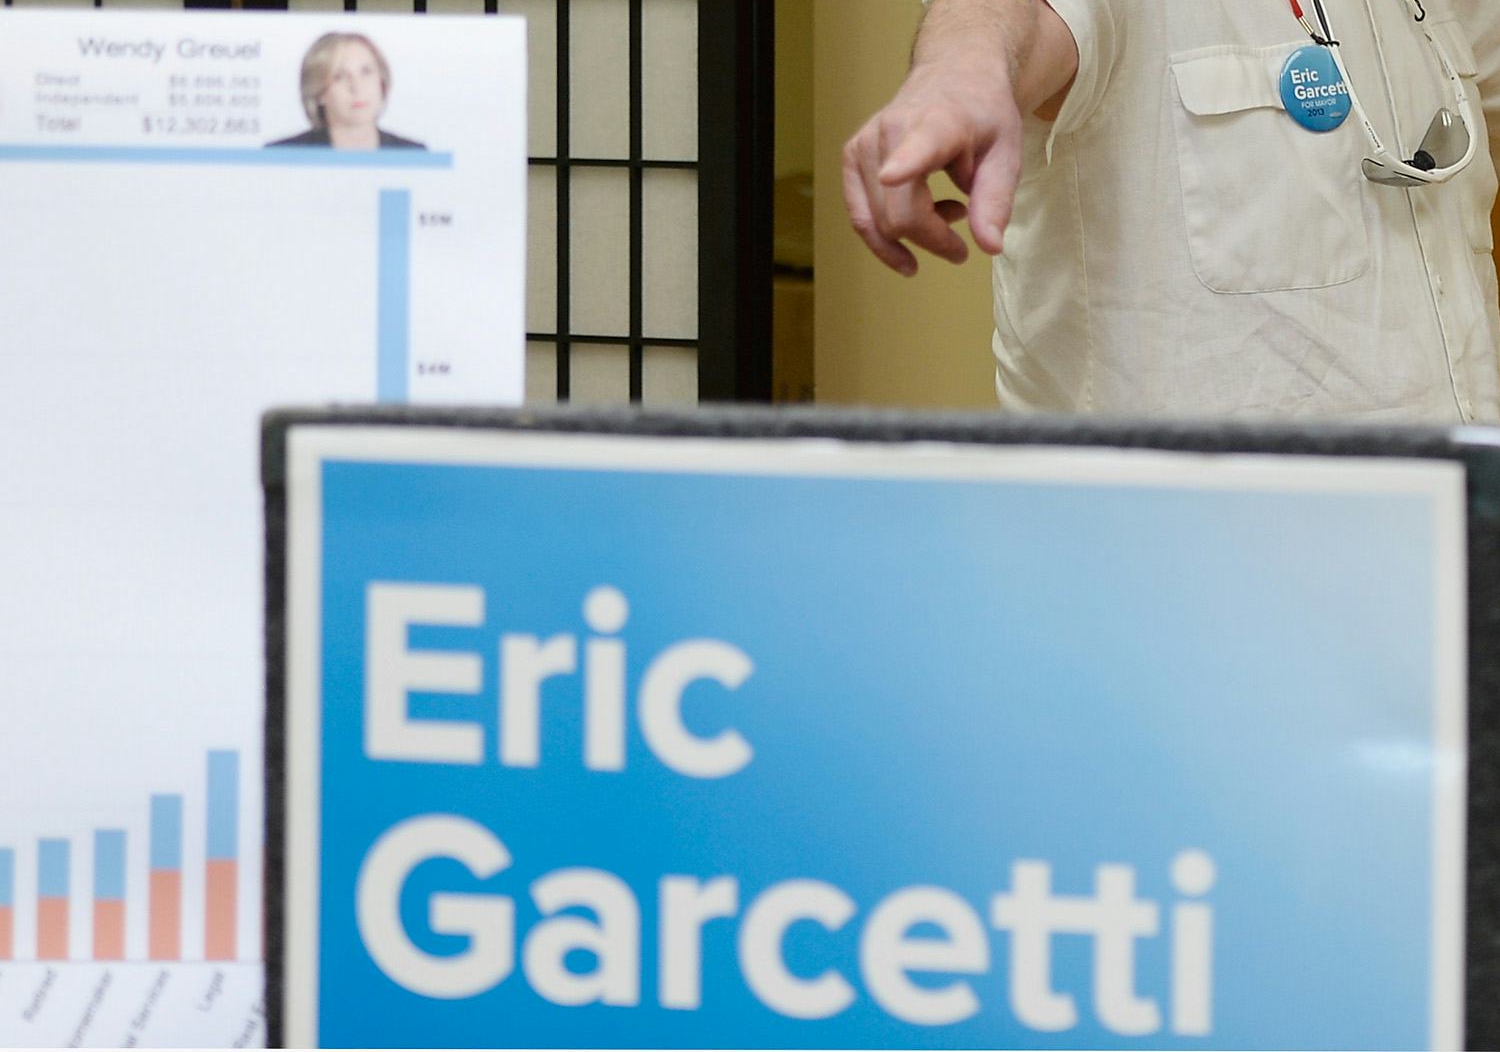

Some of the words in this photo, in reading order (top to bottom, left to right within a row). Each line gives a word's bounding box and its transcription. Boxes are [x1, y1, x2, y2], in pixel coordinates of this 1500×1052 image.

[77, 36, 167, 64] Wendy
[176, 37, 262, 60] Greuel
[1290, 68, 1320, 84] Eric
[34, 91, 140, 107] Independent
[1294, 81, 1348, 100] Garcett
[36, 114, 81, 132] Total
[362, 579, 757, 780] Eric
[354, 812, 1217, 1038] Garcetti
